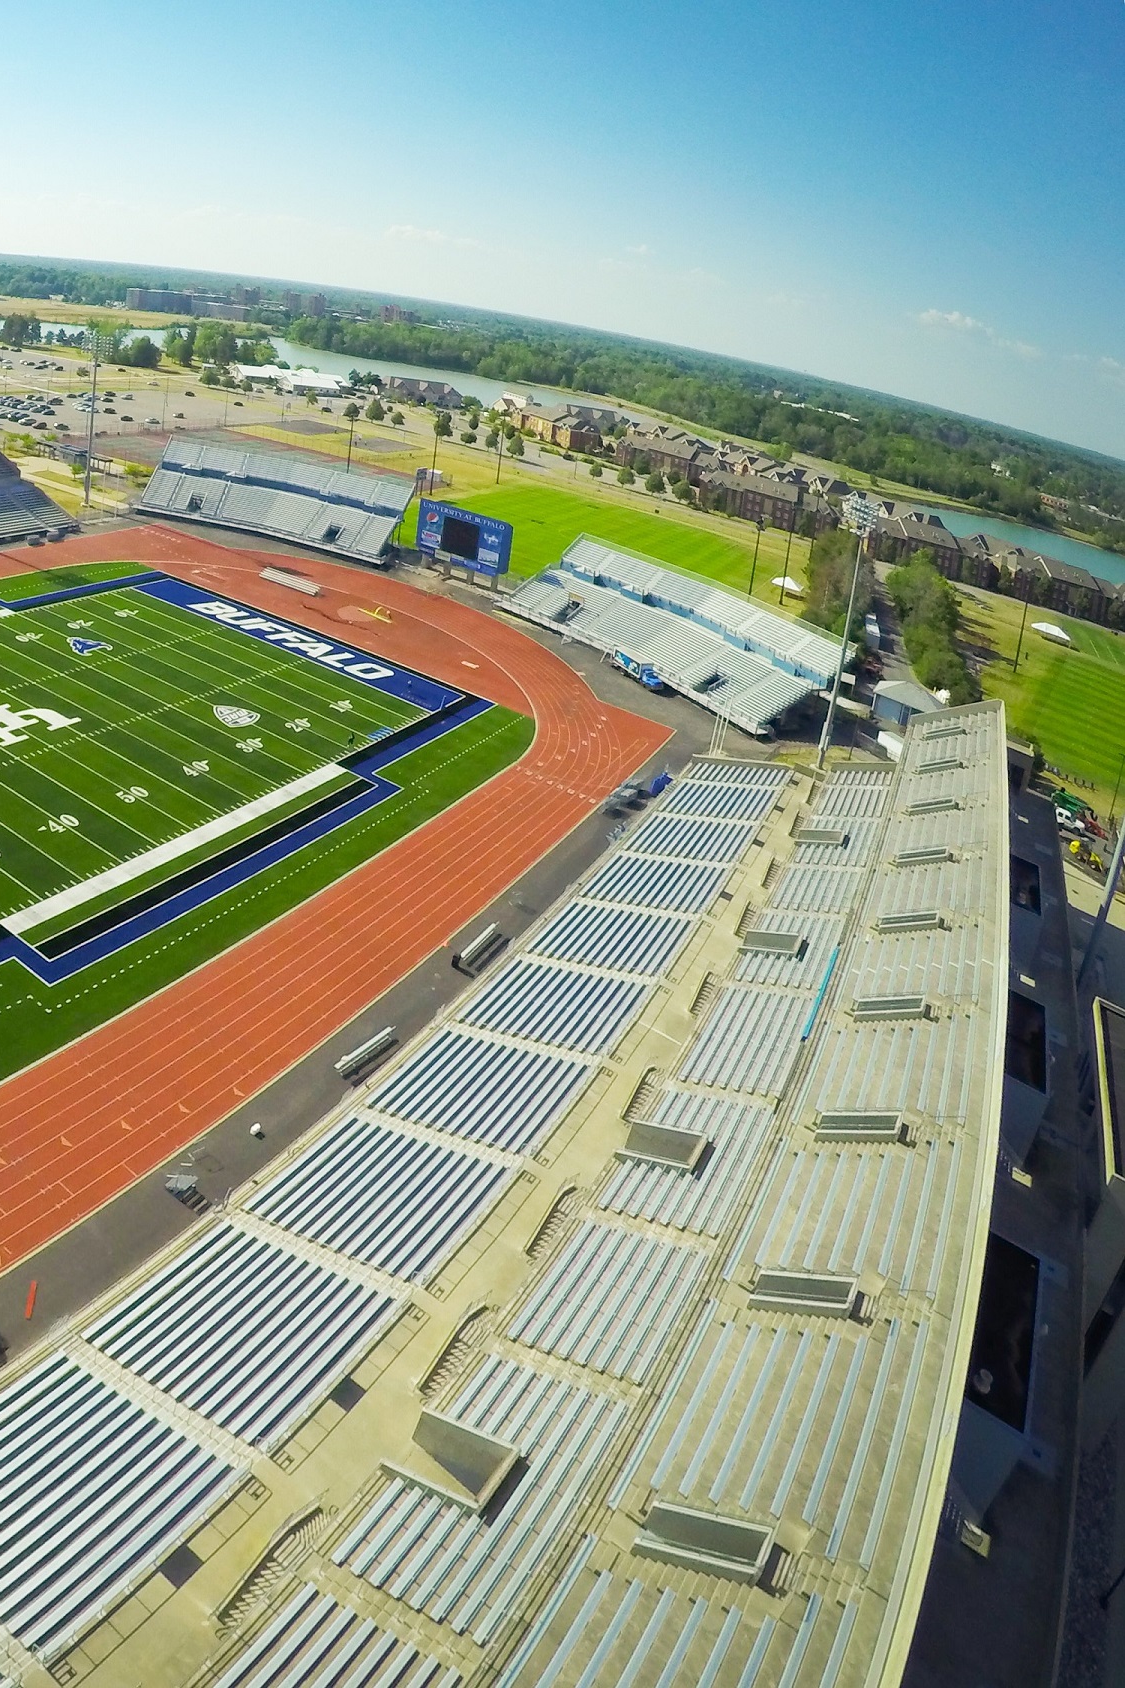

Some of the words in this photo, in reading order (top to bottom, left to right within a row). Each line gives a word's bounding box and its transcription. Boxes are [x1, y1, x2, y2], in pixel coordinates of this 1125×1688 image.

[423, 502, 463, 518] UNIVERSITY
[475, 517, 505, 531] BUFFALO
[186, 601, 395, 680] BUFFALO
[329, 701, 353, 713] 10
[285, 719, 312, 733] 20
[235, 739, 264, 753] 30
[182, 761, 210, 777] 40
[115, 786, 150, 804] 50
[47, 814, 80, 834] 40
